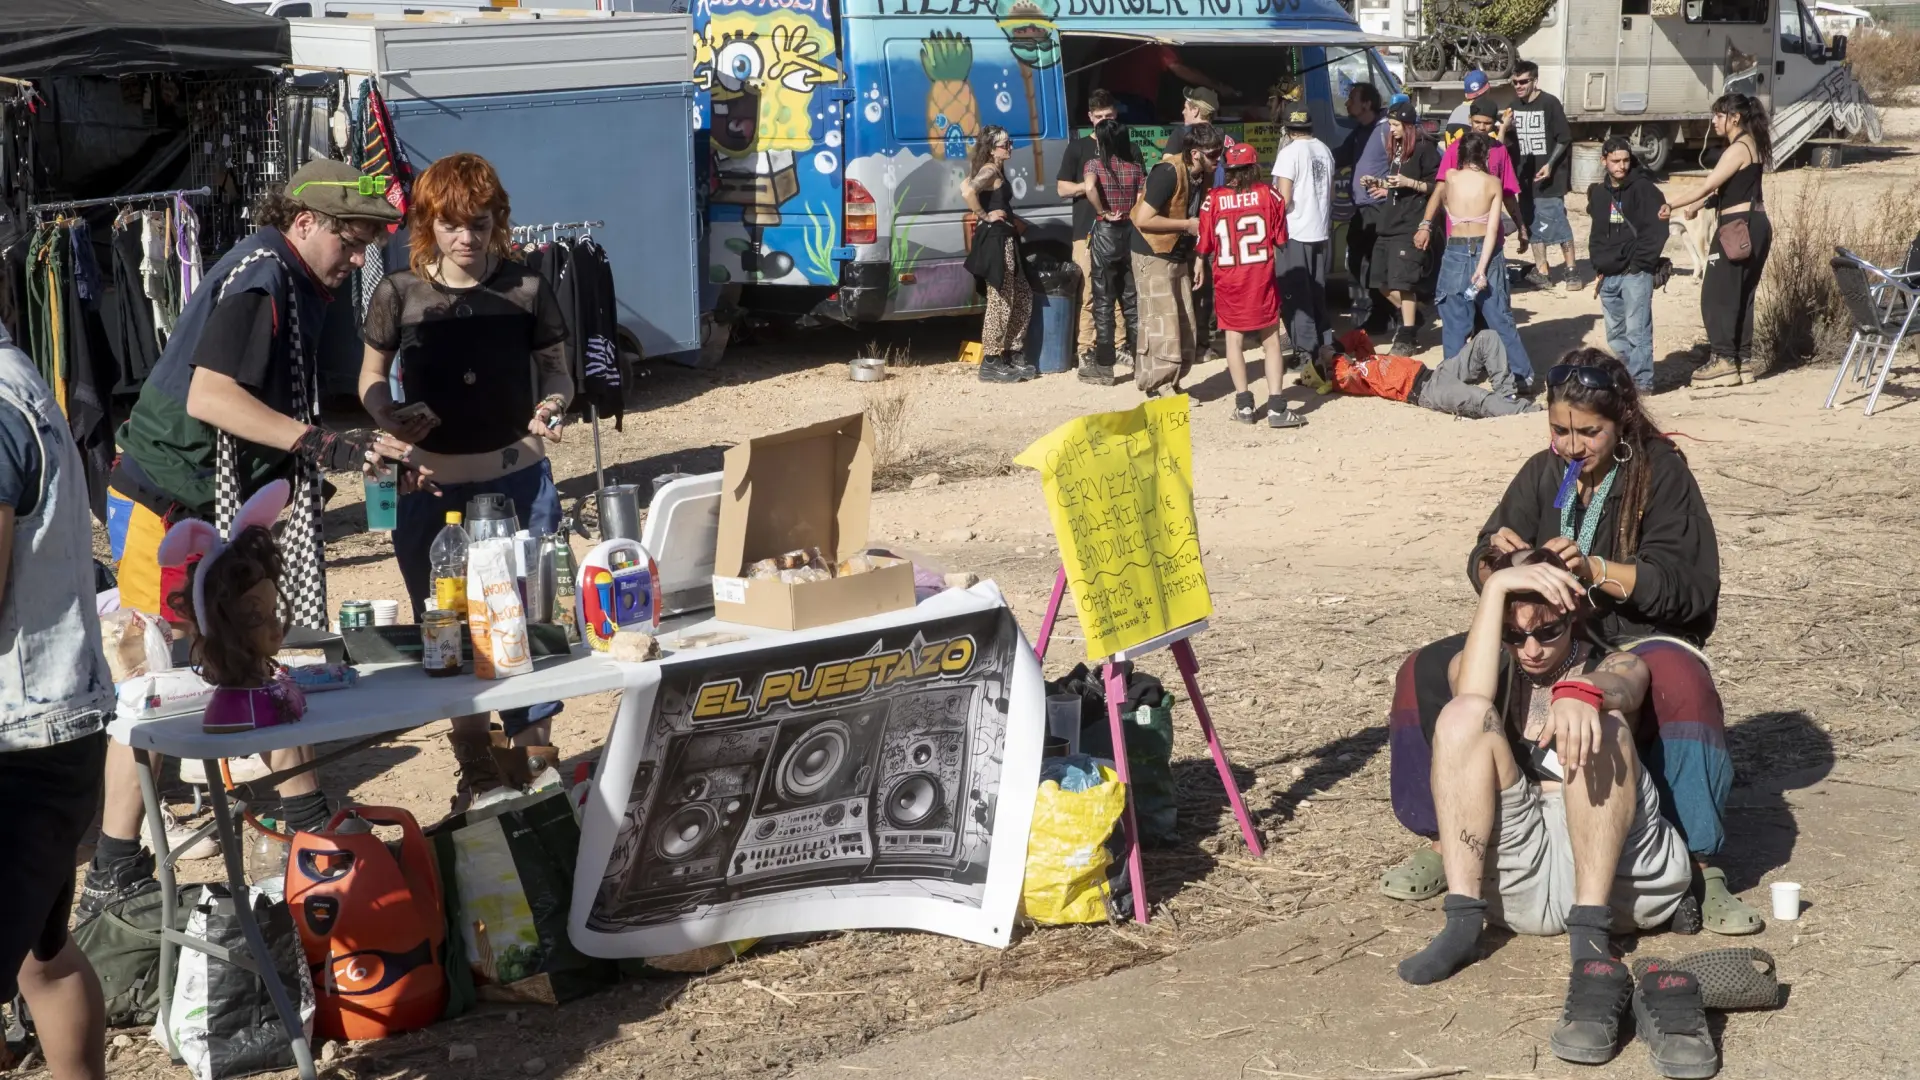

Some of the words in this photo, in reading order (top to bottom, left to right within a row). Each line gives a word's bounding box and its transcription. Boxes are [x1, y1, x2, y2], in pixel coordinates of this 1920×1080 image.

[1219, 191, 1258, 210] DILFER
[1214, 214, 1268, 267] 12
[1056, 462, 1144, 509] CERVEZA
[1159, 494, 1176, 514] 1€
[1076, 529, 1151, 571] SANDWICH
[1155, 554, 1192, 578] TABACO
[1080, 579, 1134, 613] OFERTAS
[691, 680, 752, 722] EL
[756, 636, 975, 713] PUESTAZO
